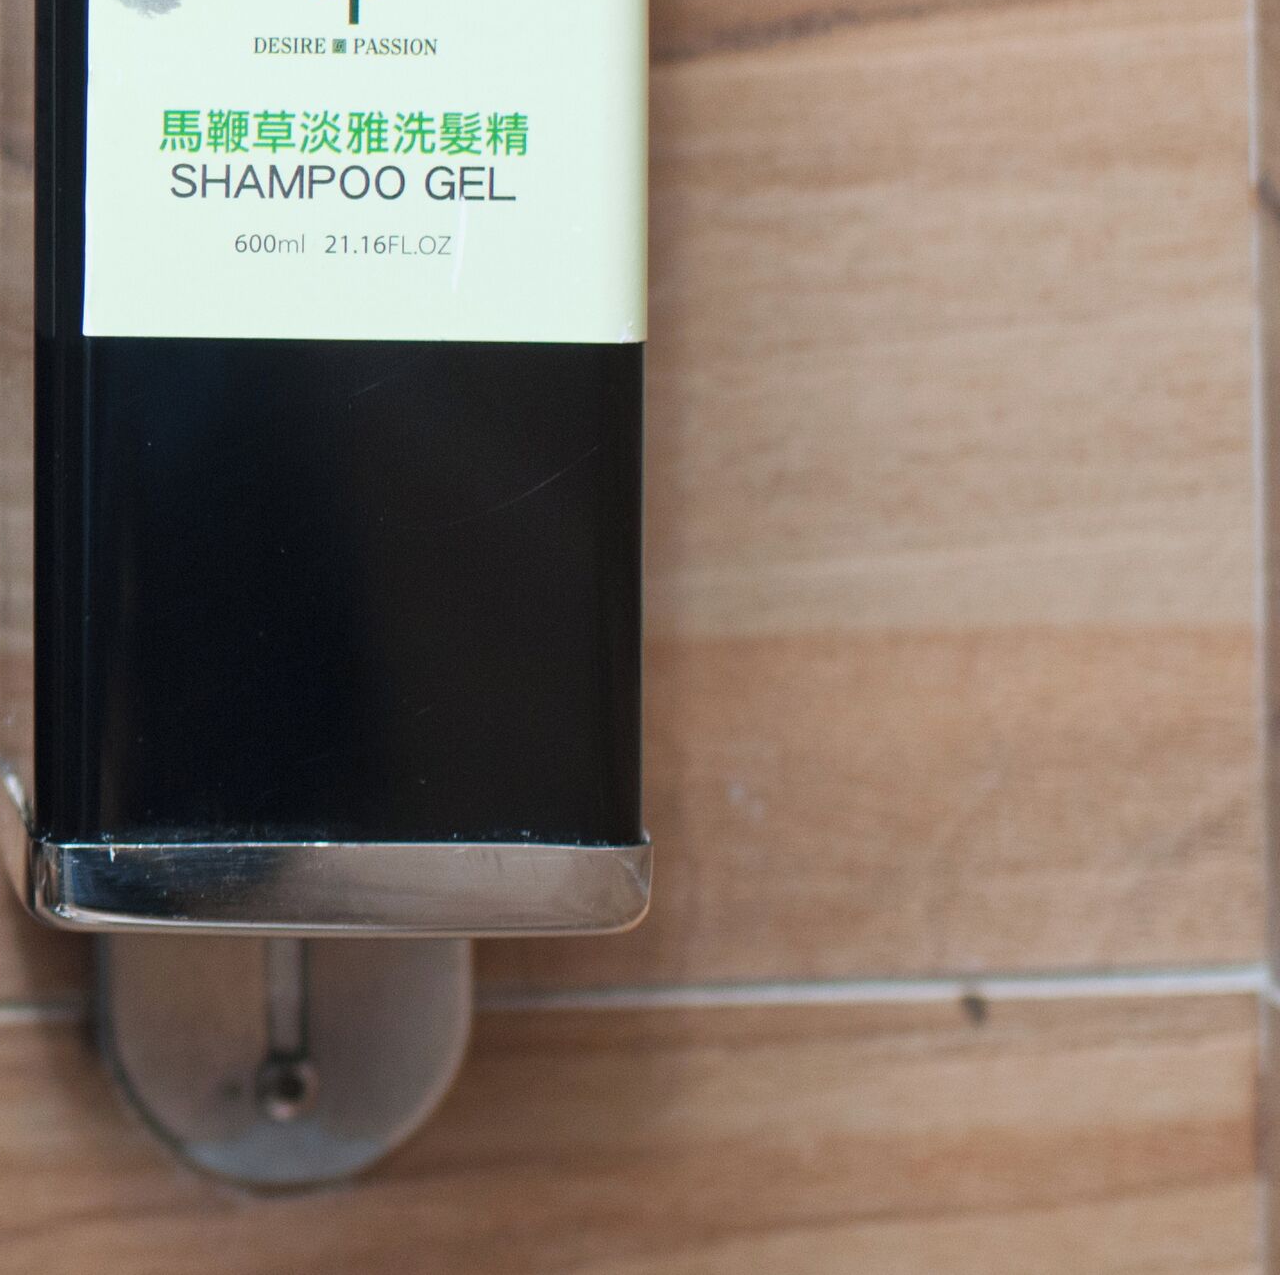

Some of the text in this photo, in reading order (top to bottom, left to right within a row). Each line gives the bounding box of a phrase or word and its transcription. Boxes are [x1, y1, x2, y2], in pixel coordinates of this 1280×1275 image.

[254, 37, 326, 54] DESIRE
[353, 38, 437, 55] PASSION
[159, 109, 529, 156] 馬鞭草淡雅洗髮精
[170, 164, 516, 201] SHAMPOO GEL
[234, 234, 452, 255] 600ml 21.16FL.OZ
